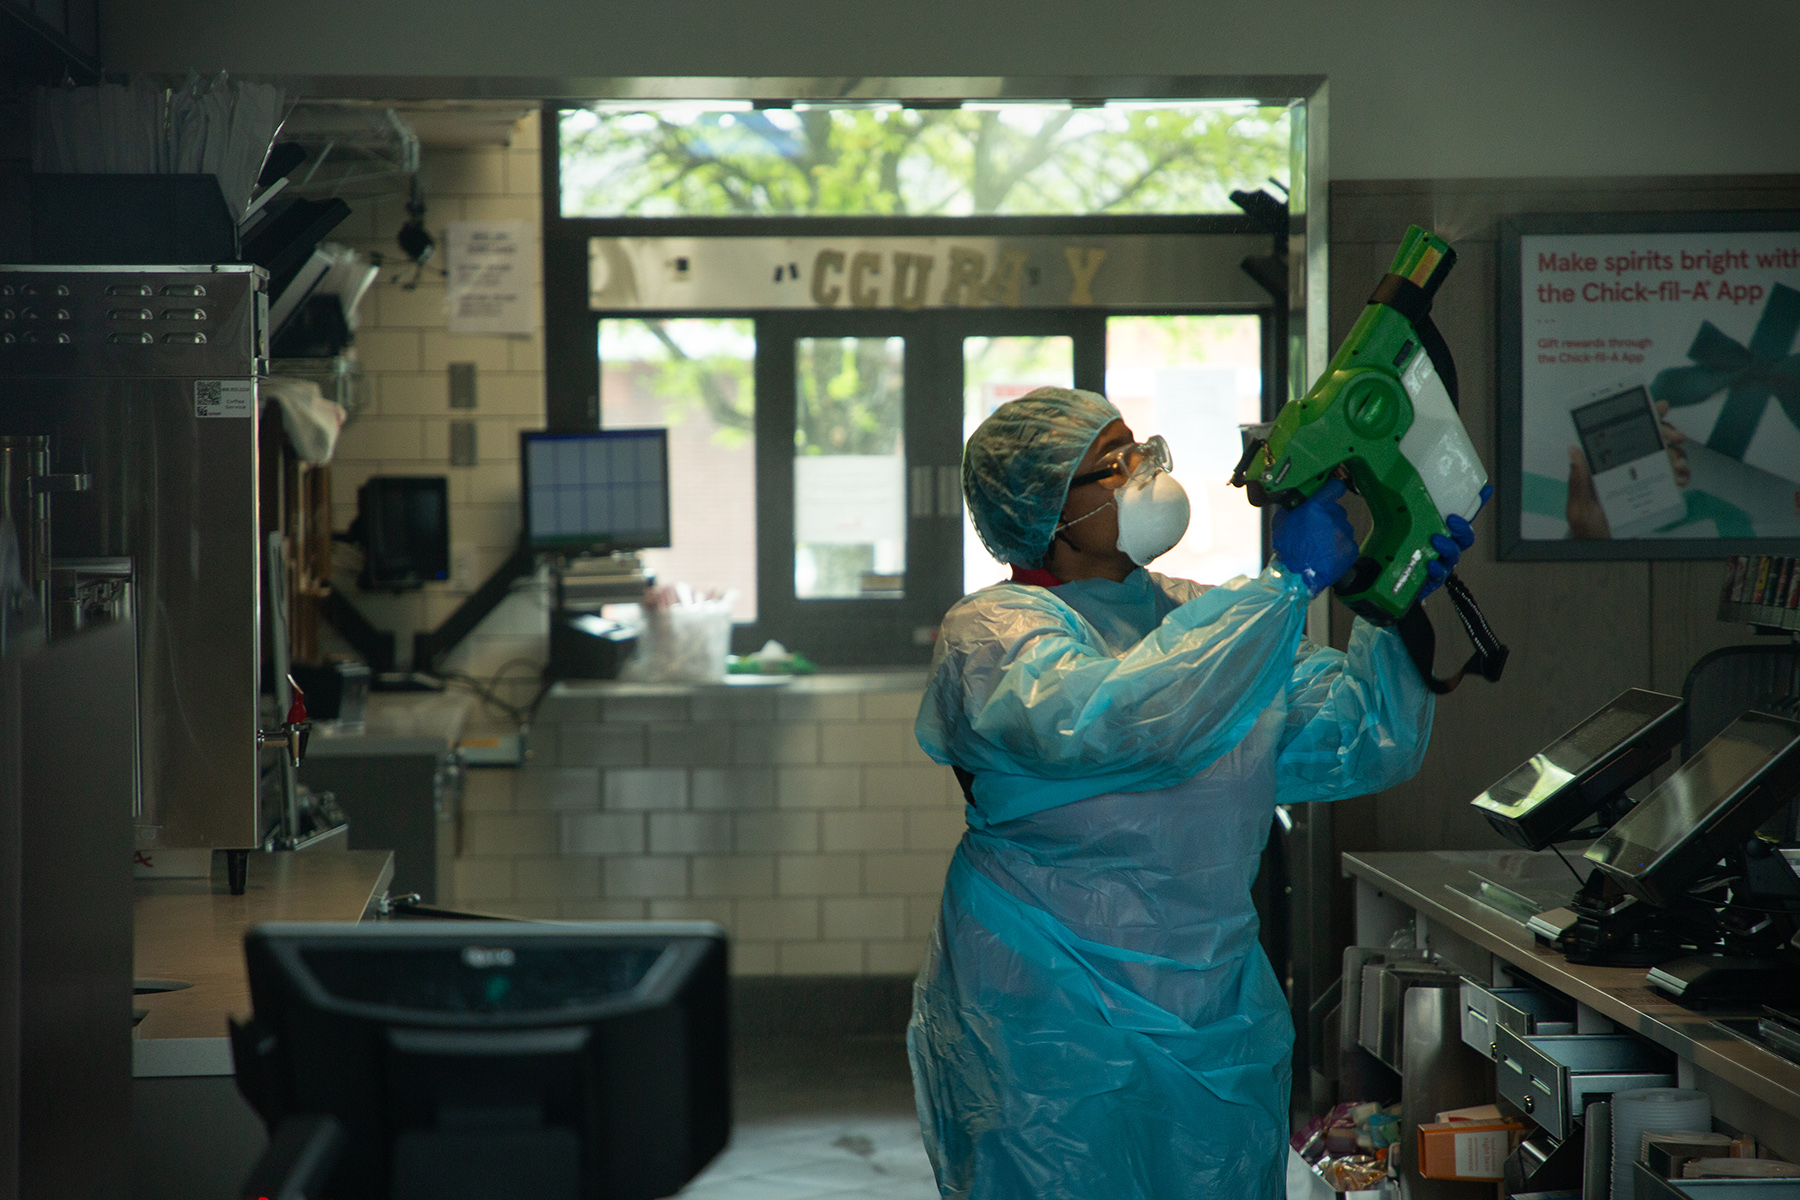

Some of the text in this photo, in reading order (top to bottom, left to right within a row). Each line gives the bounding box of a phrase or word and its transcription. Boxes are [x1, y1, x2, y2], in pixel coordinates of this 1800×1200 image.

[1538, 252, 1597, 272] Make
[1604, 249, 1674, 276] spirits
[1681, 249, 1749, 275] bright
[1537, 283, 1576, 302] the
[1717, 281, 1764, 305] App
[1562, 338, 1605, 348] rewards
[1608, 337, 1653, 350] through
[1621, 351, 1645, 363] App
